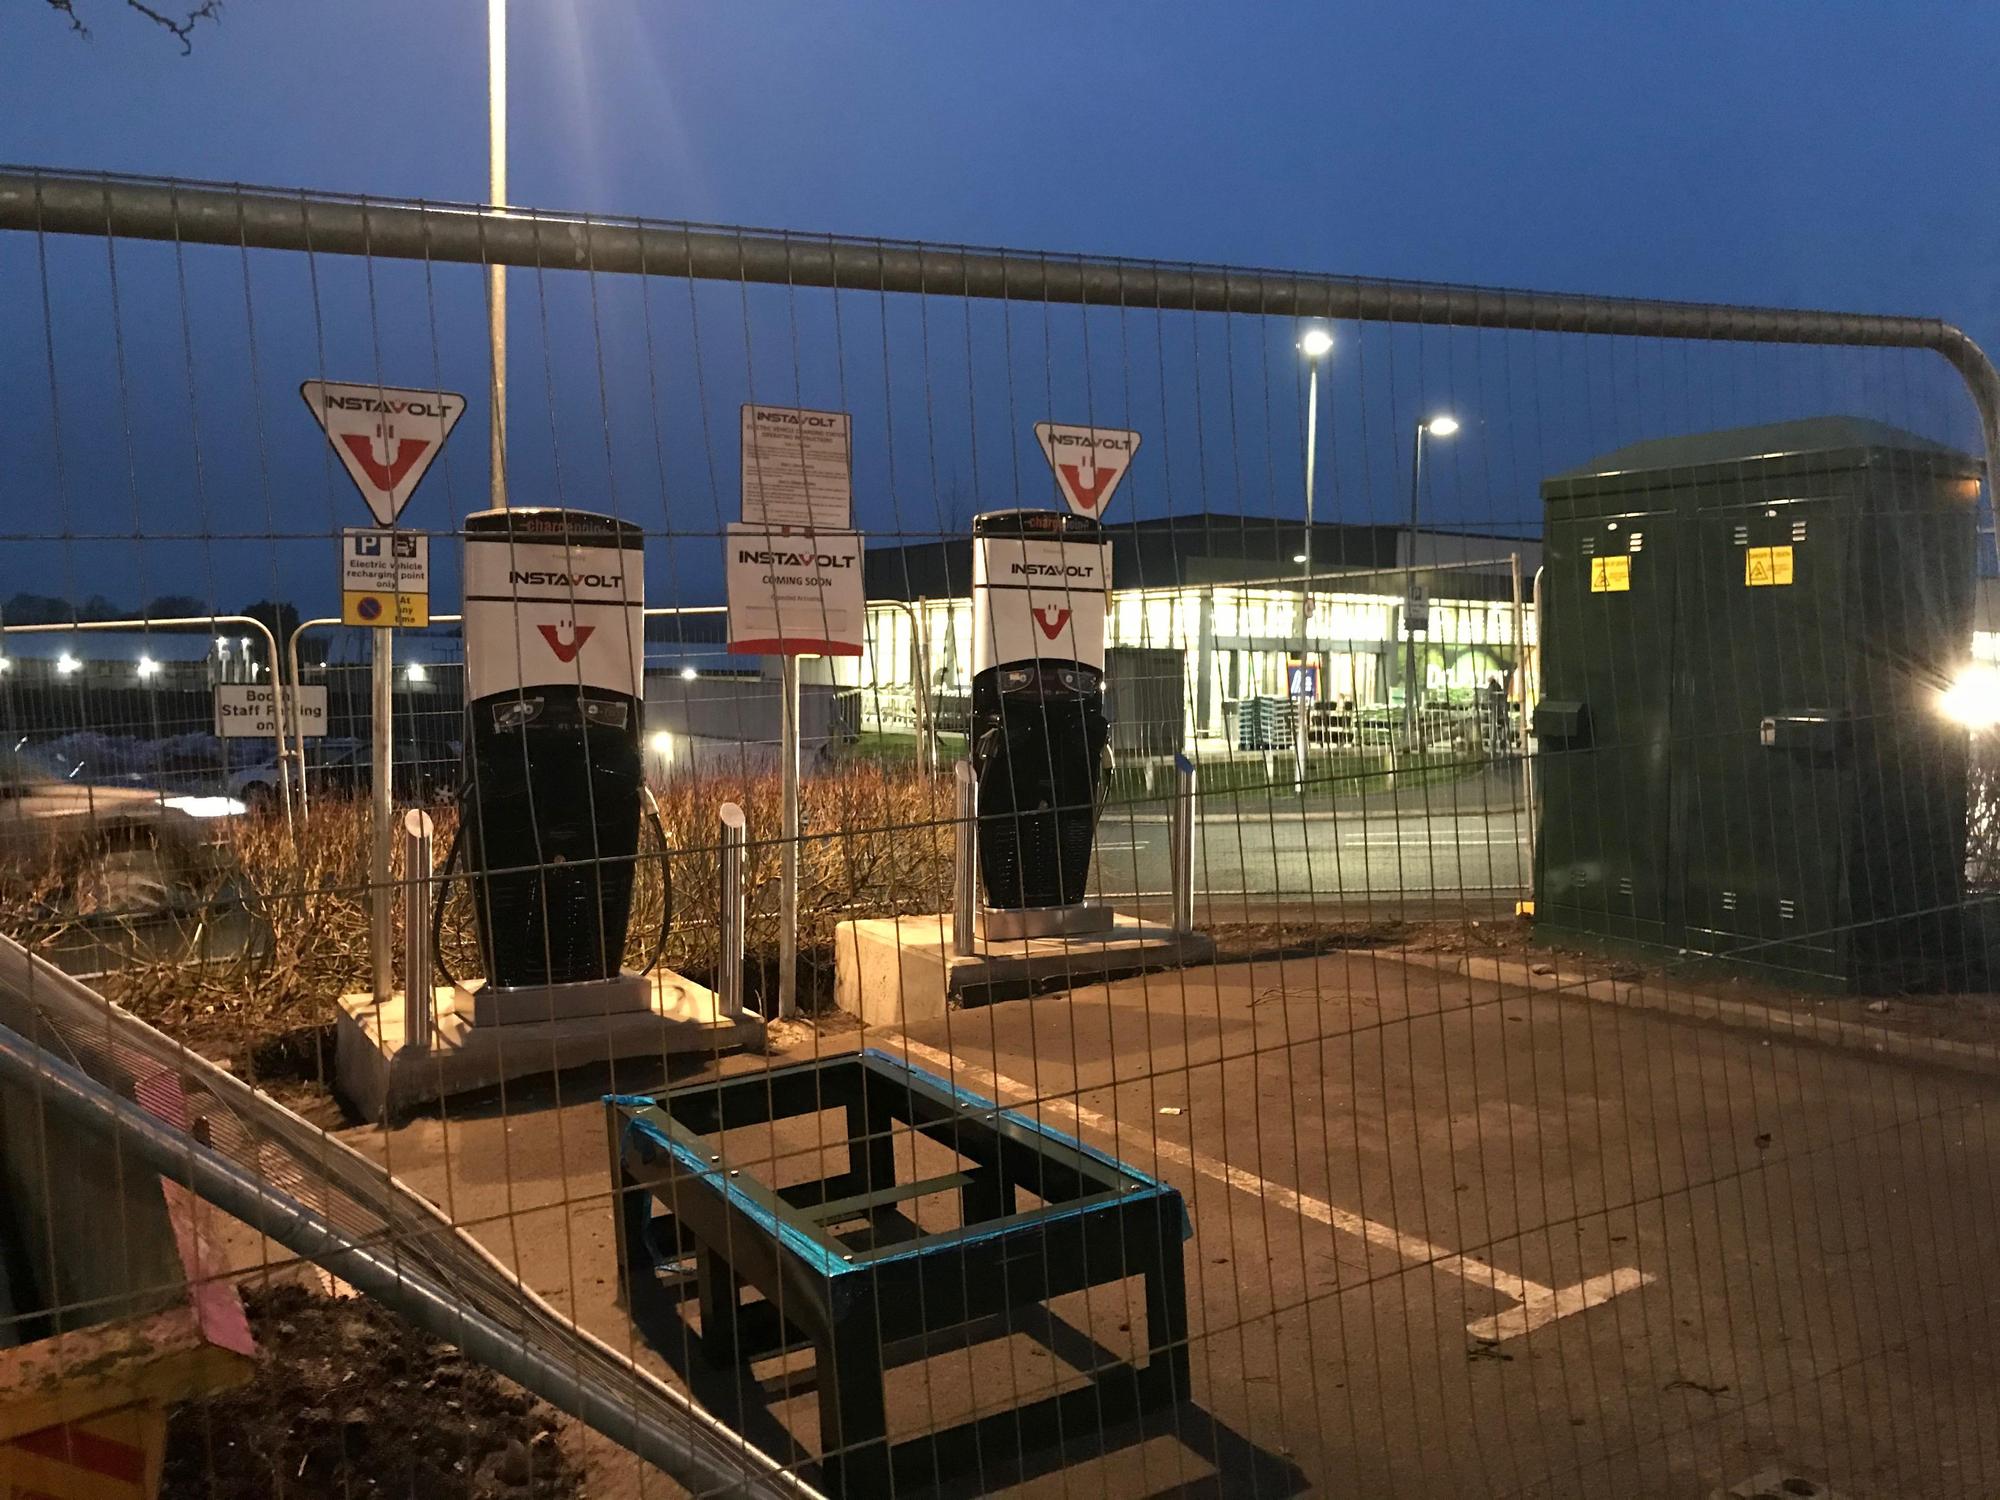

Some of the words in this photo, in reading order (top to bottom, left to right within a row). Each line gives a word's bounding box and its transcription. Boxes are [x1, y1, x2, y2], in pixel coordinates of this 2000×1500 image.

[325, 395, 452, 418] INSTAVOLT
[757, 412, 836, 427] INSTAVOLT
[1048, 434, 1131, 450] INSTAVOLT
[350, 560, 387, 568] Electric
[390, 562, 422, 570] vhicle
[739, 550, 855, 568] INSTAVOLT
[401, 572, 424, 580] point
[1011, 563, 1093, 577] INSTAVOLT
[509, 571, 622, 588] INSTAVOLT
[762, 575, 802, 586] COMING
[805, 577, 832, 587] SOON
[400, 596, 410, 604] At
[395, 615, 415, 623] tme
[246, 690, 290, 701] Booh
[222, 705, 260, 716] Staff
[266, 705, 322, 718] Pring
[256, 722, 288, 731] ony
